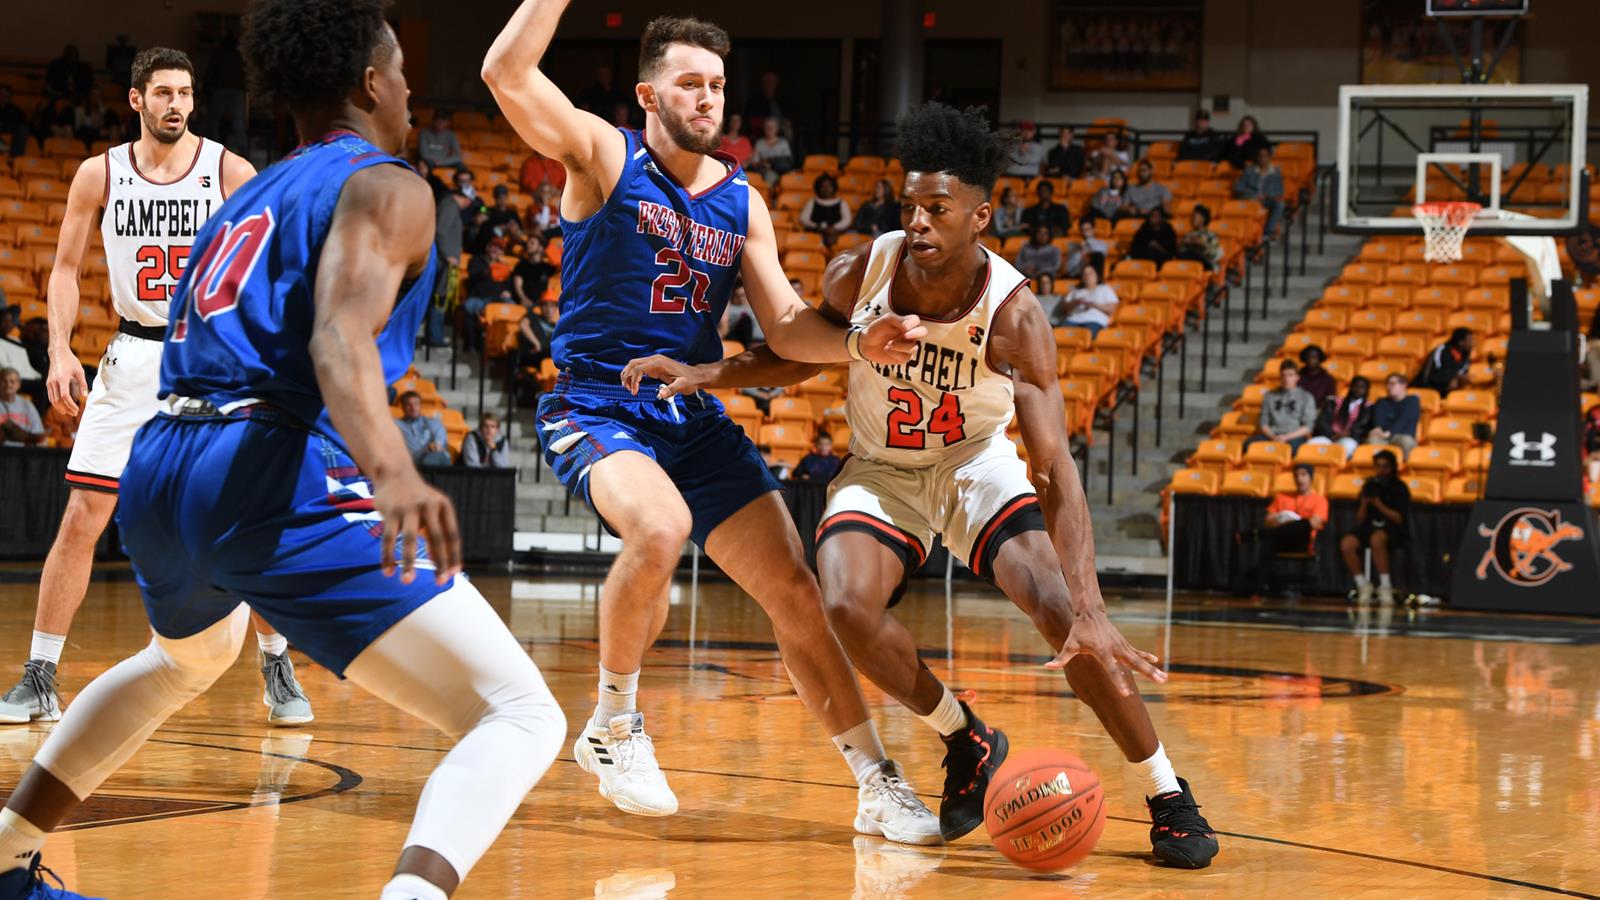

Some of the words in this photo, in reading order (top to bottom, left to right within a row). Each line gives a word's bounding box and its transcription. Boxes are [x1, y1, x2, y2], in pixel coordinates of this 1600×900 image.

[637, 200, 746, 267] PRESBYTERIAN
[136, 245, 194, 301] 25
[868, 340, 978, 392] PBELL
[886, 386, 966, 450] 24
[995, 776, 1072, 825] SPALDING
